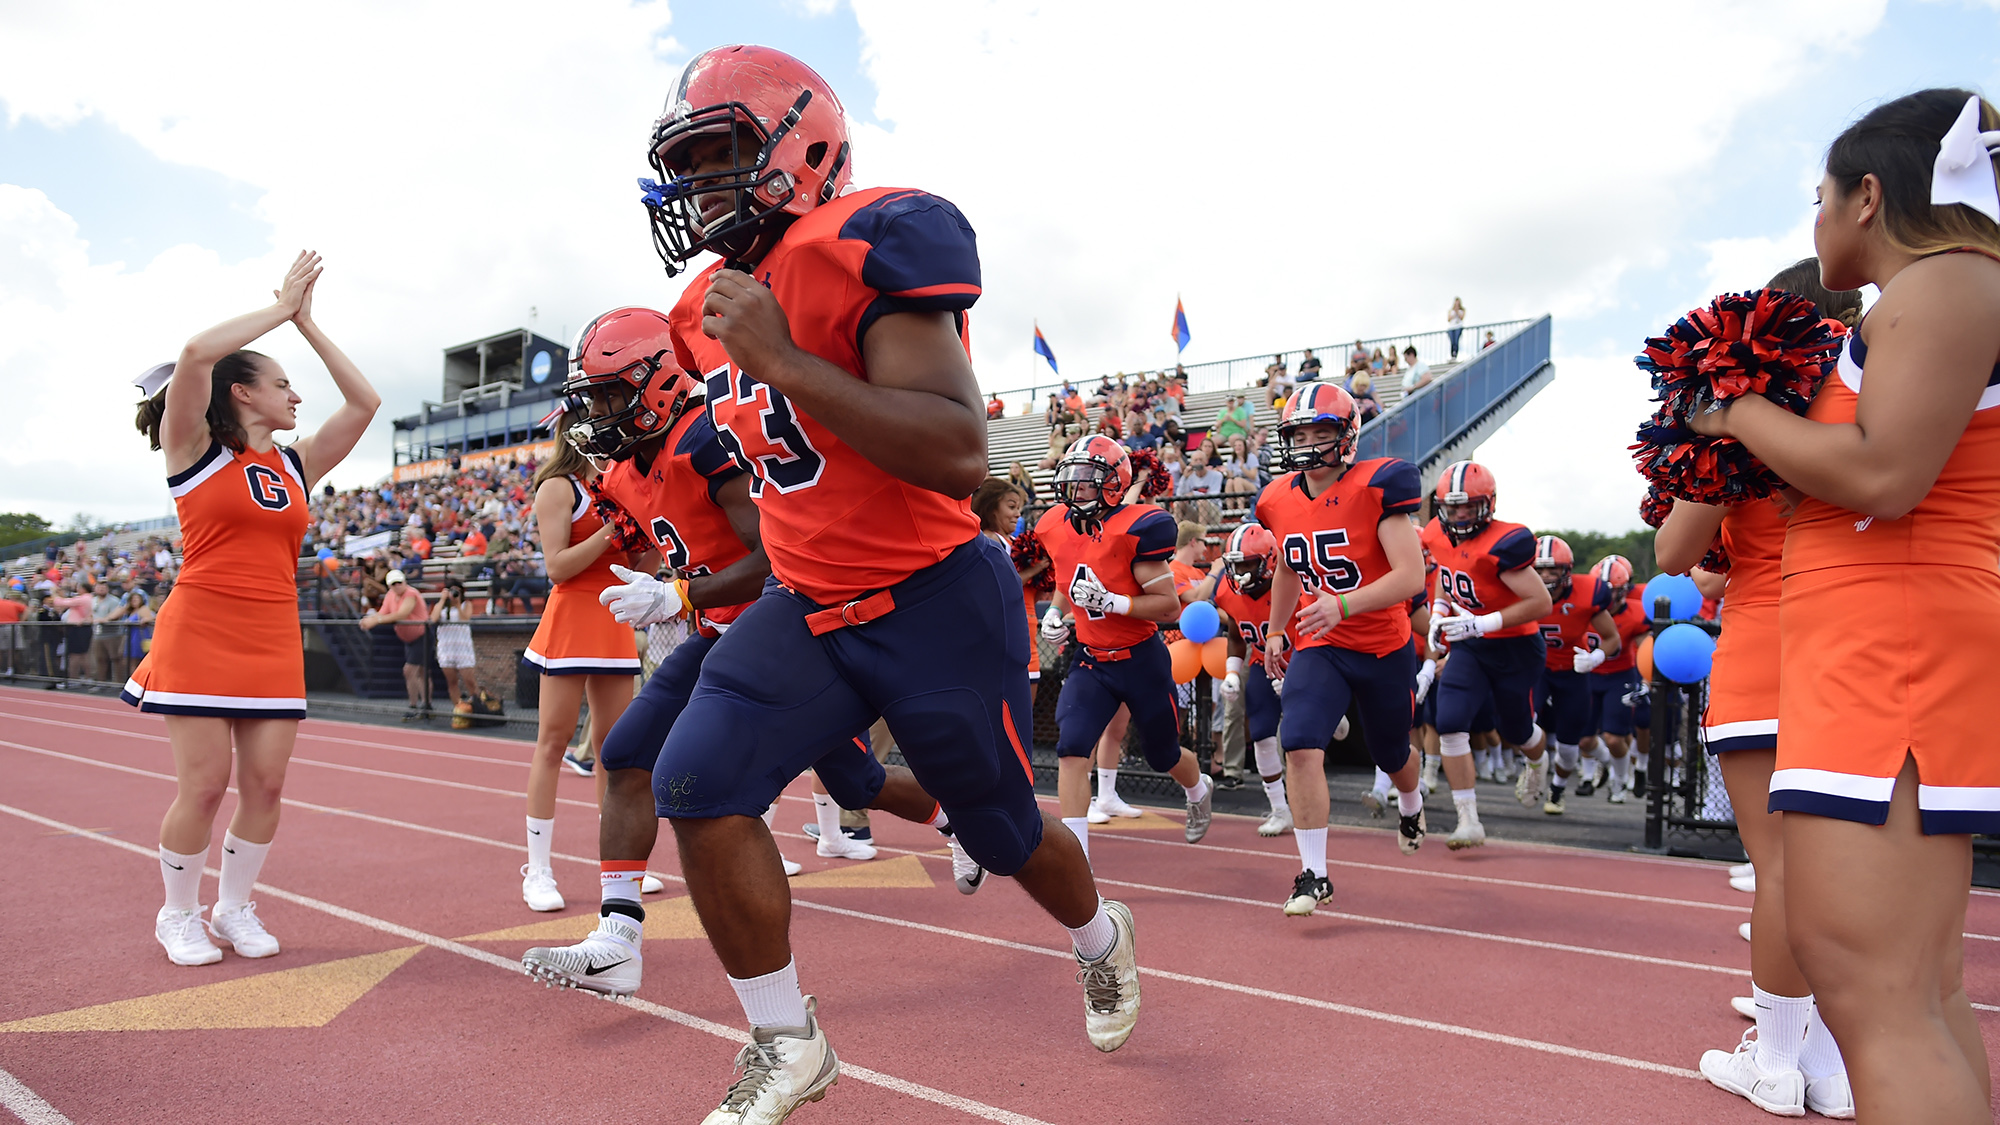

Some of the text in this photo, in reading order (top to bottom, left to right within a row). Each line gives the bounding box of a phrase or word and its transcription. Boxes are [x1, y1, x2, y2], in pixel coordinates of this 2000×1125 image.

[704, 361, 827, 498] 53
[243, 462, 291, 512] G
[617, 925, 638, 943] NIKE
